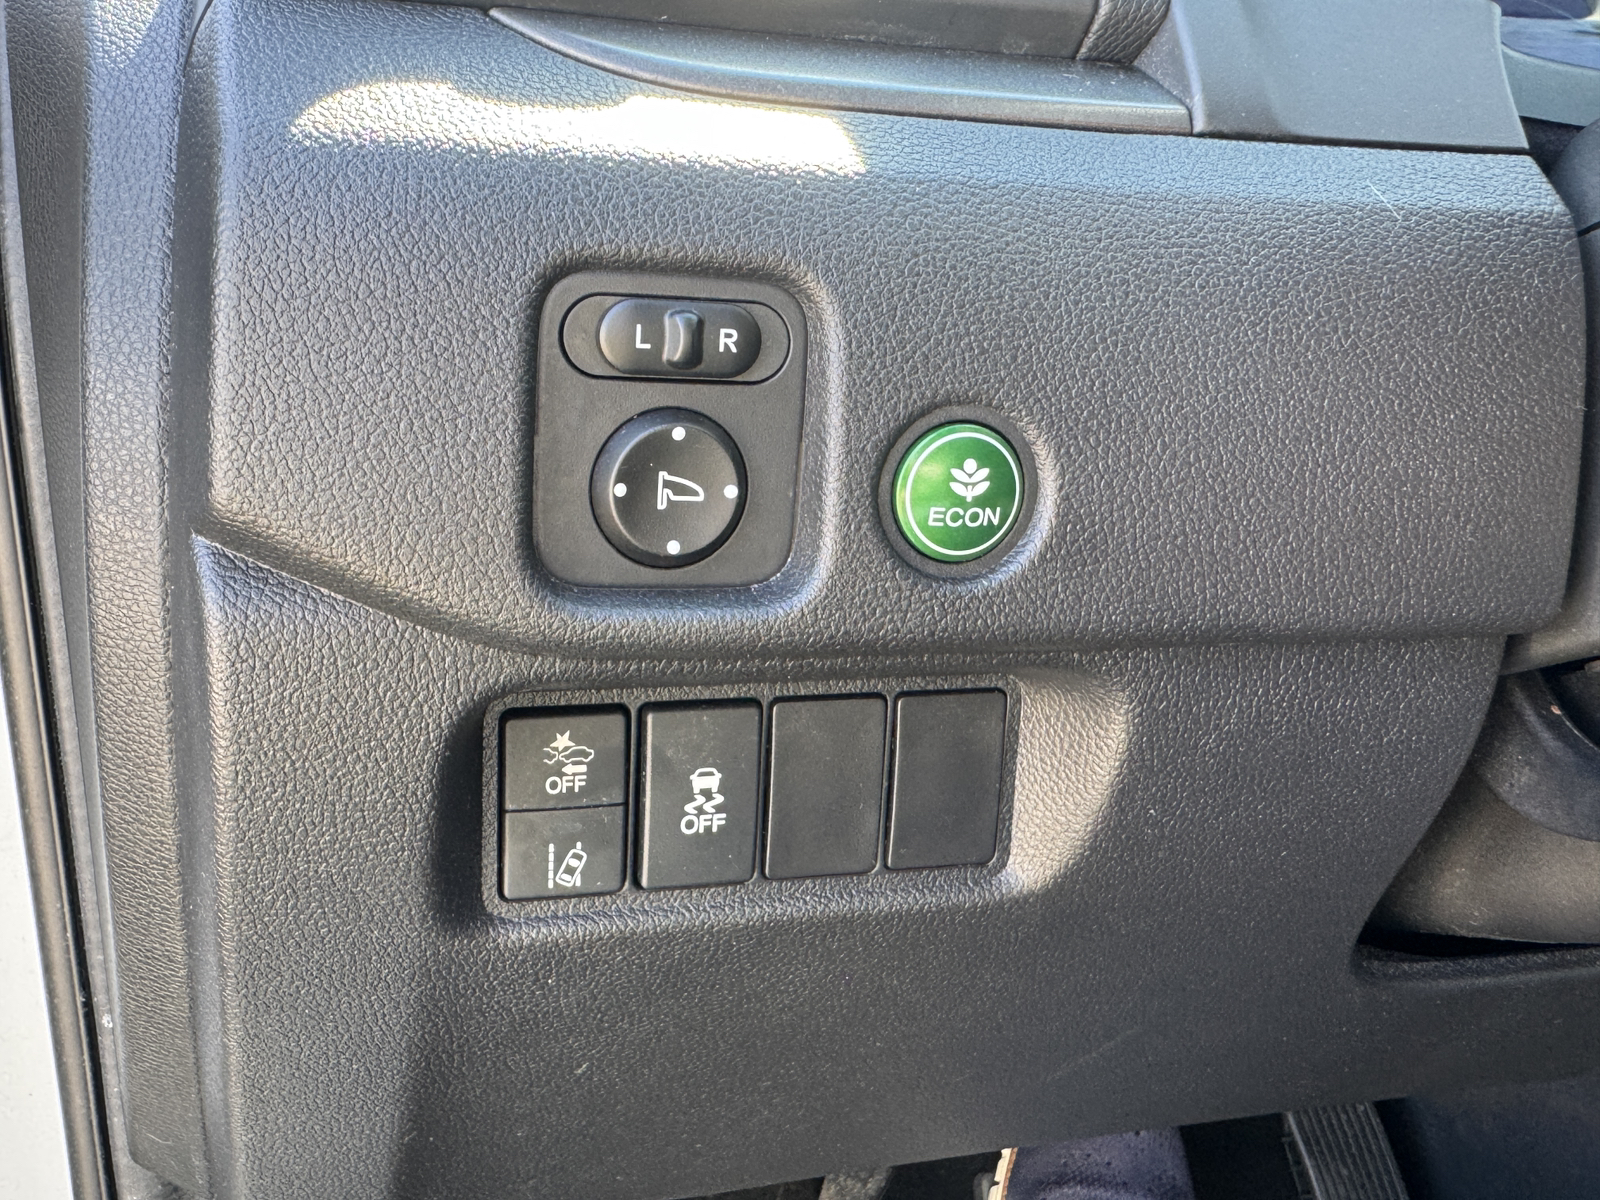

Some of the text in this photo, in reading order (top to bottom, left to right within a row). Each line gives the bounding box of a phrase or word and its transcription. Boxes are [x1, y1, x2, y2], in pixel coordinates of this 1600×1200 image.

[635, 324, 651, 349] L
[718, 328, 738, 353] R
[927, 506, 1001, 527] ECON
[545, 775, 587, 794] OFF
[680, 813, 727, 835] OFF
